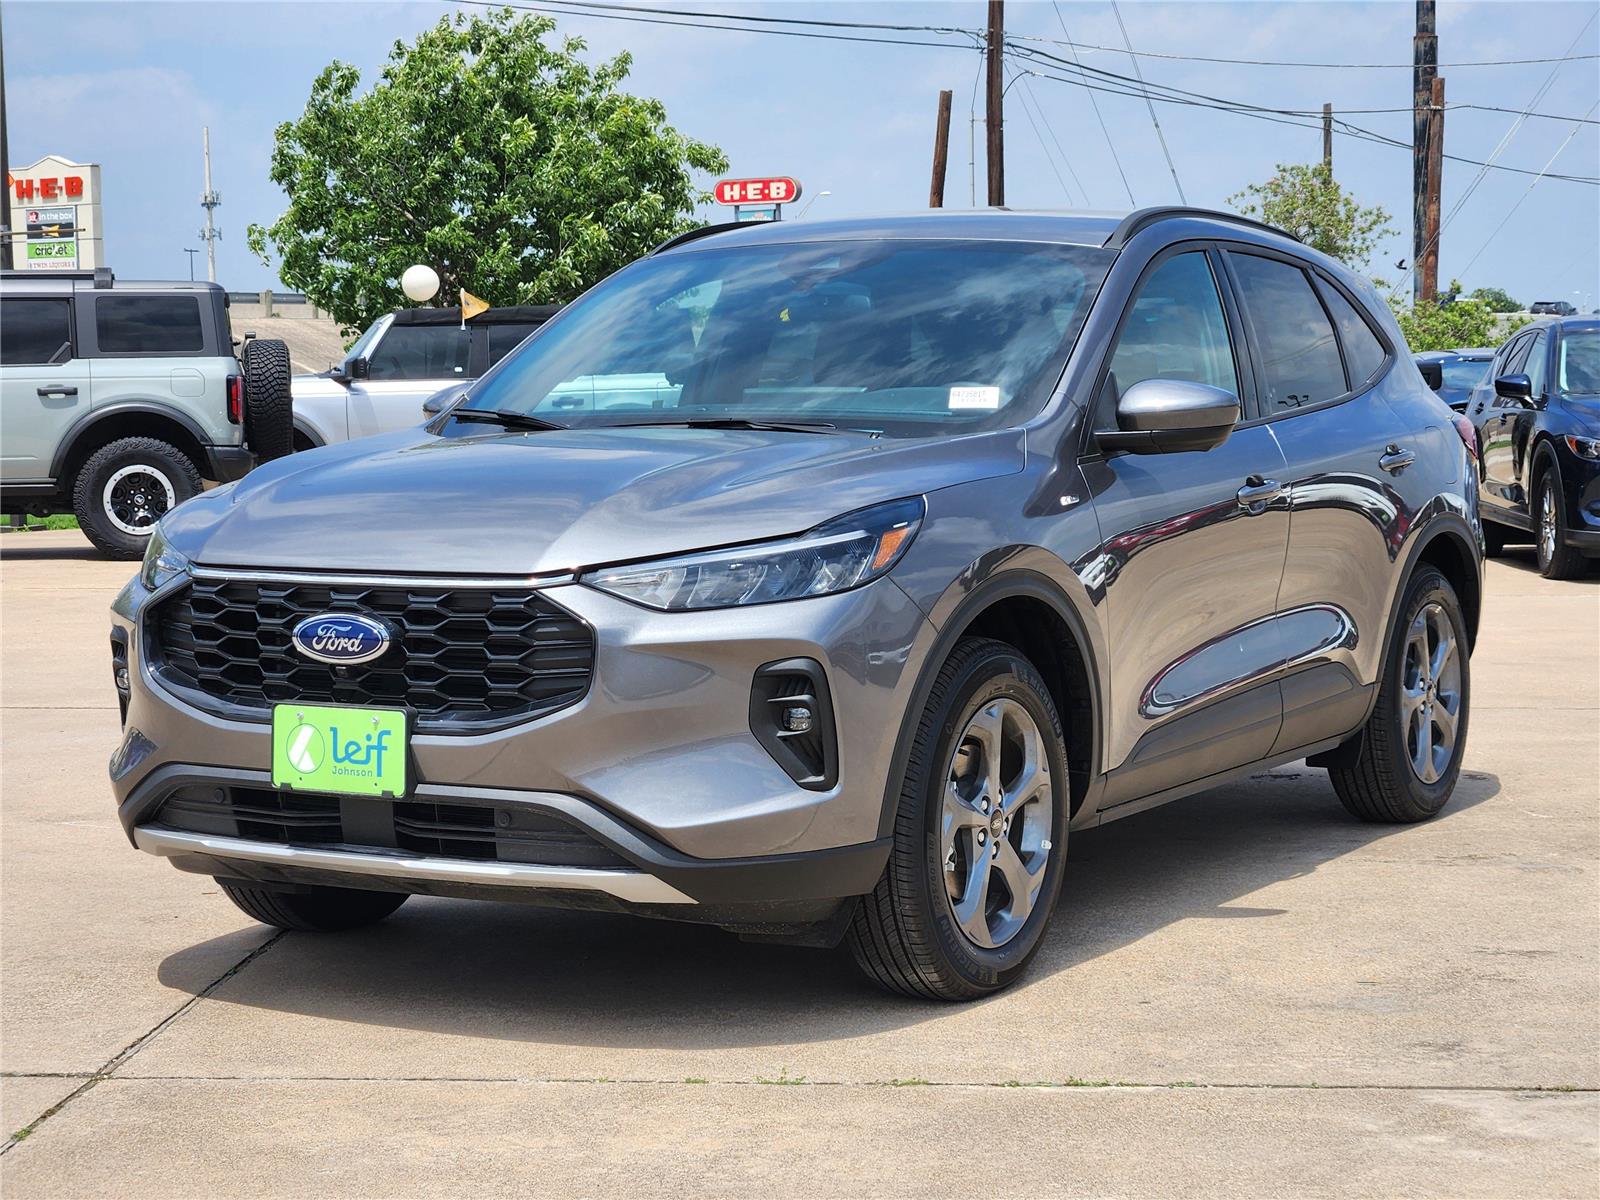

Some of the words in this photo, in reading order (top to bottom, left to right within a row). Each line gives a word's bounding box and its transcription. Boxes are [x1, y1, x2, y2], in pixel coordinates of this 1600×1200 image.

[312, 623, 364, 653] Ford
[1030, 676, 1062, 736] MICHELIN
[329, 727, 392, 778] leif
[332, 766, 373, 777] Johnson
[939, 918, 978, 976] MICHELIN
